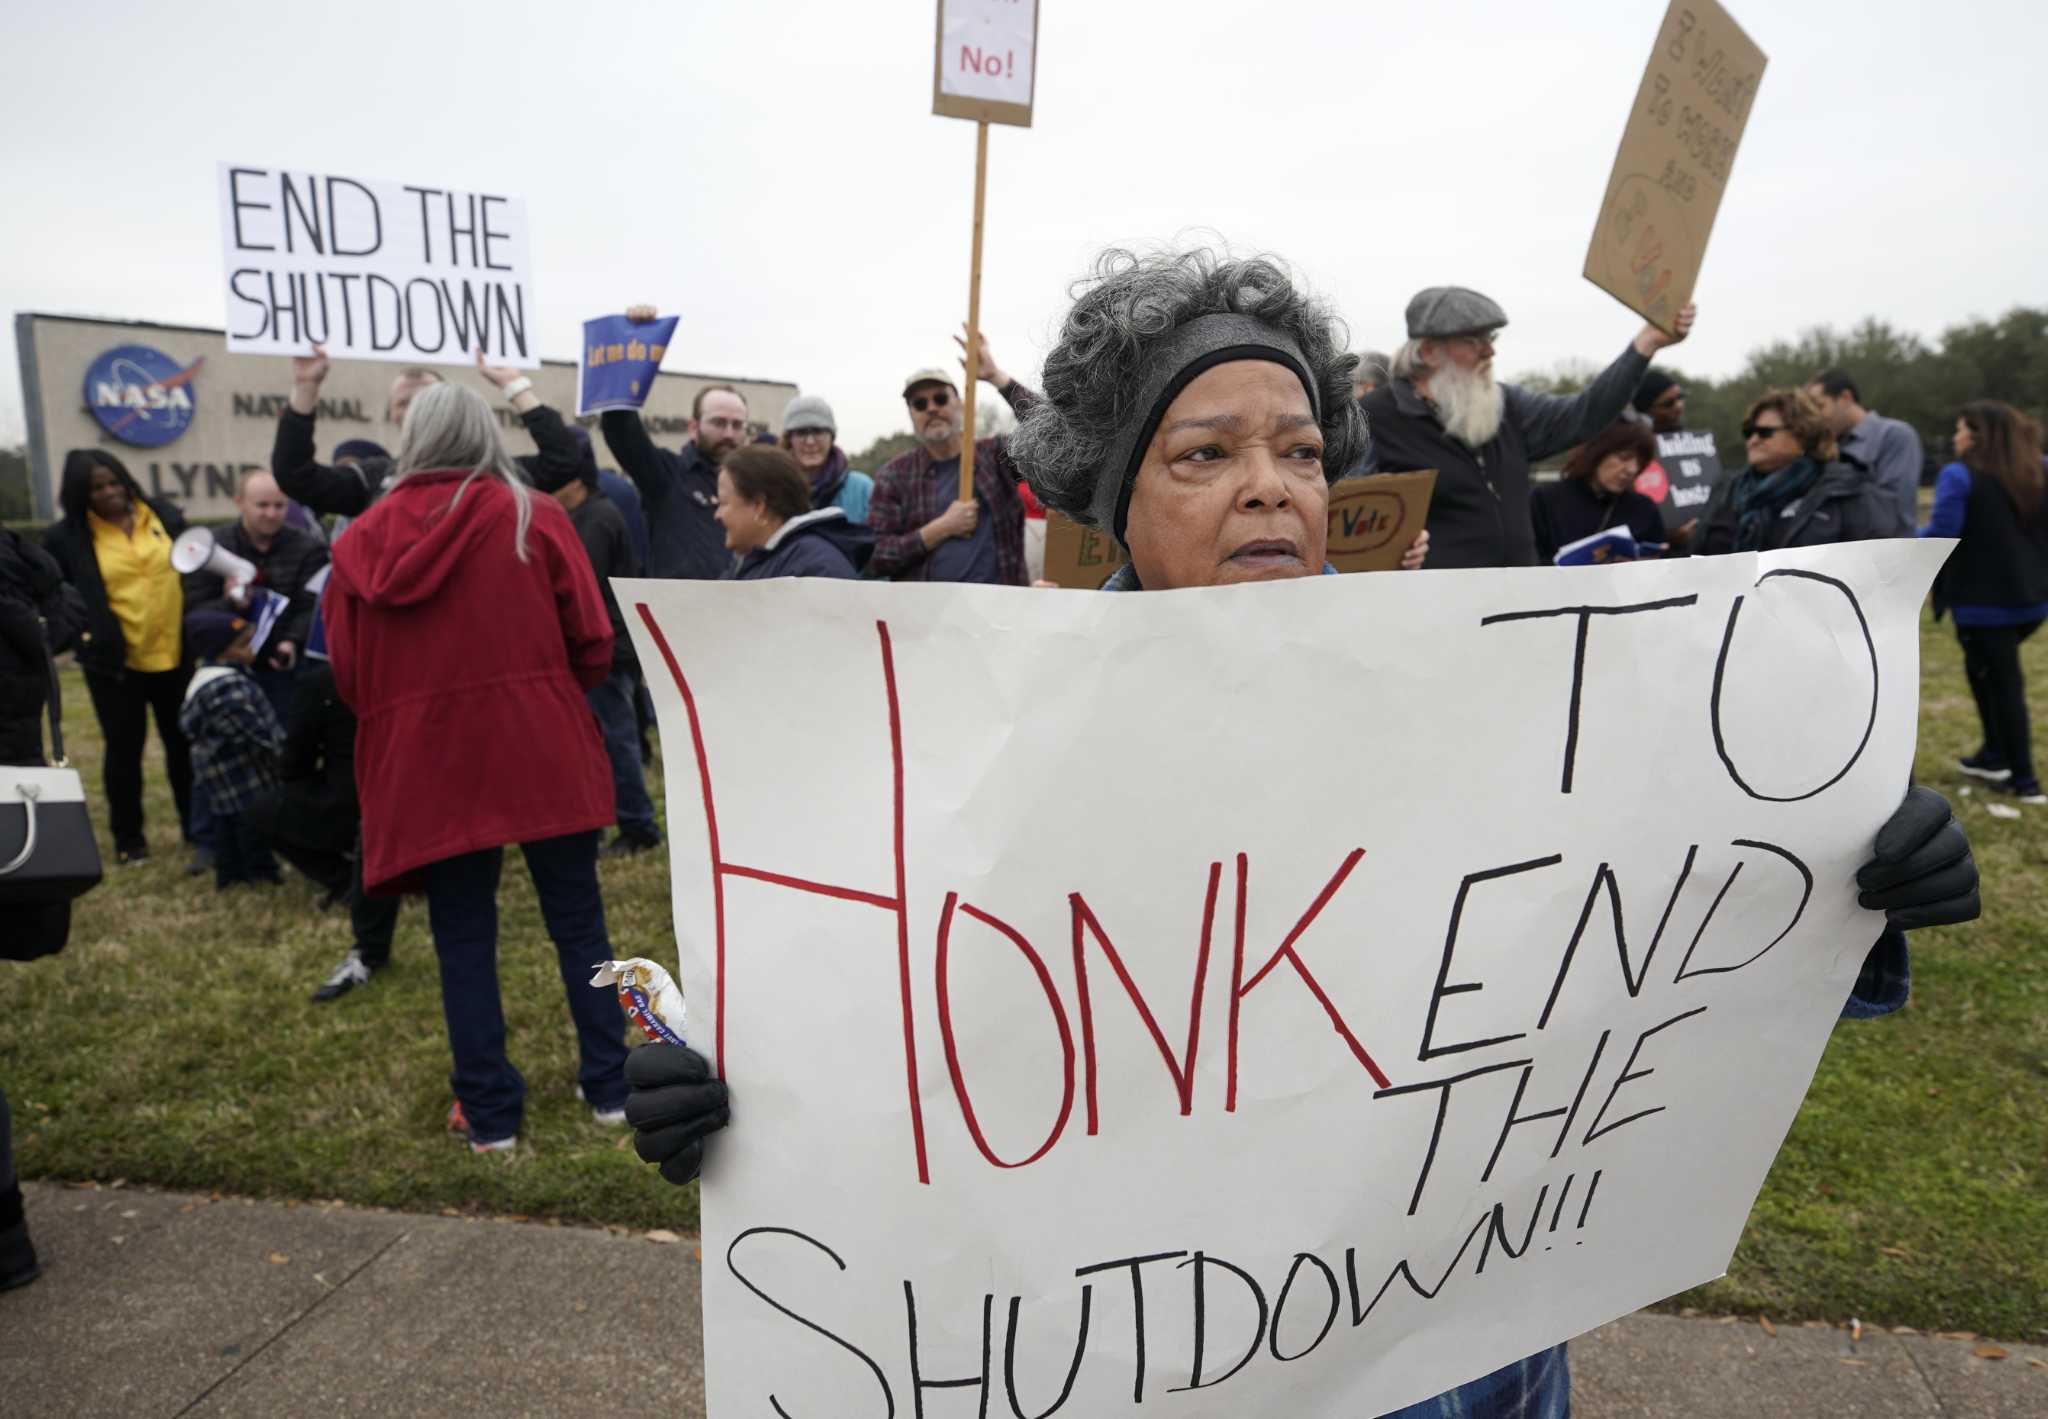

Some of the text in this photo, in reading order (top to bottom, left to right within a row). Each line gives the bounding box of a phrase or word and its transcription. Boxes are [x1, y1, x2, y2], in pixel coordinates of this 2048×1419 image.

[960, 44, 1014, 79] No!
[229, 168, 513, 272] END THE
[230, 268, 529, 358] SHUTDOWN
[627, 337, 646, 361] do
[95, 380, 192, 410] NASA
[232, 391, 372, 423] NATNAL
[1481, 567, 1879, 802] TO
[635, 602, 1392, 1185] HONK
[1417, 838, 1814, 1062] END
[1371, 1005, 1708, 1217] THE
[727, 1168, 1602, 1419] SHUTDOWN!!
